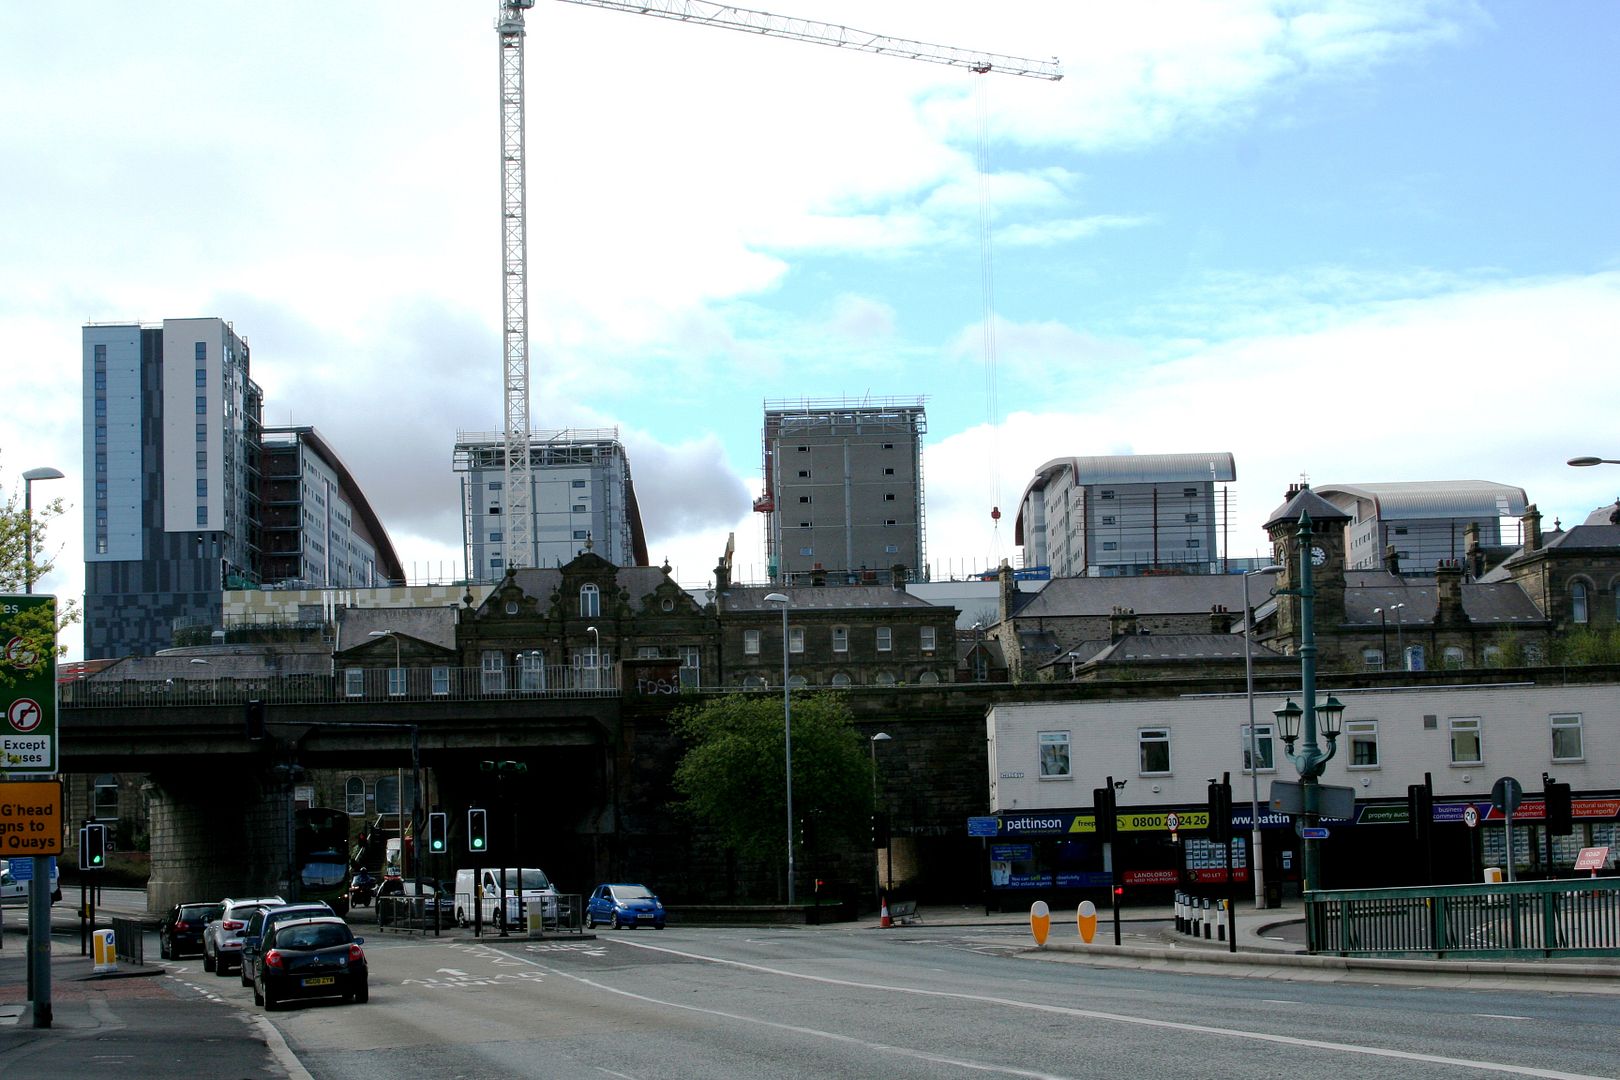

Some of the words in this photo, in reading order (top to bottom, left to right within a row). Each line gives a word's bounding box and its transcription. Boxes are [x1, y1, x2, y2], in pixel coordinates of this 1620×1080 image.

[3, 604, 19, 614] es
[4, 739, 46, 751] Except
[1, 803, 53, 816] G'head
[0, 823, 24, 835] gns
[30, 820, 45, 831] to
[1007, 817, 1062, 831] pattinson
[1132, 816, 1161, 827] 0800
[1168, 817, 1177, 827] 30
[9, 835, 55, 849] Quays
